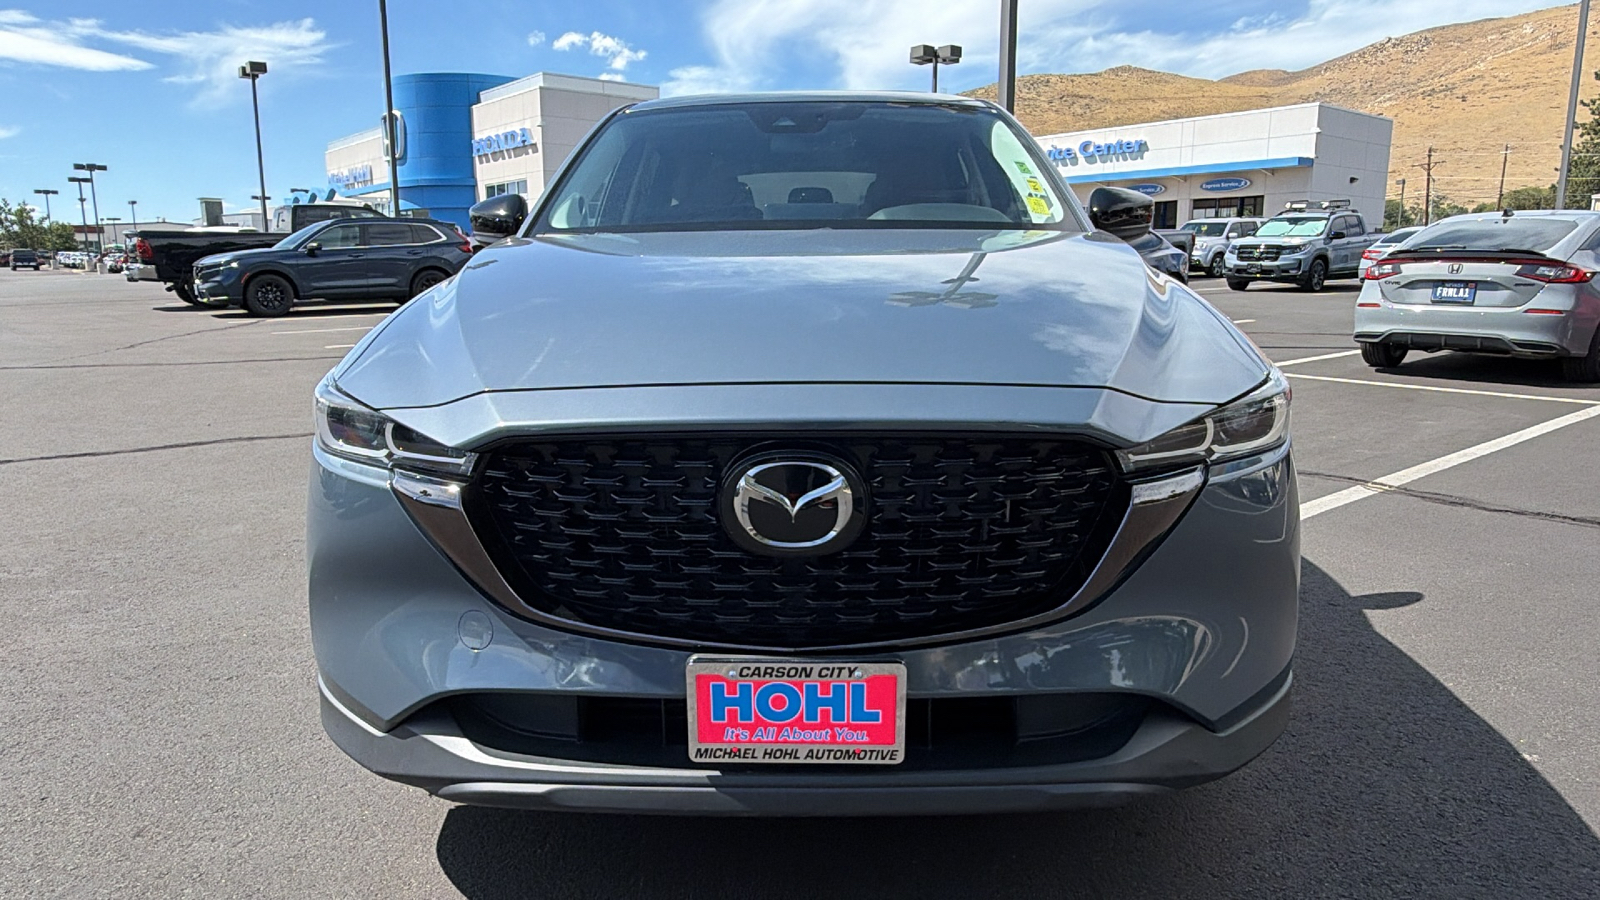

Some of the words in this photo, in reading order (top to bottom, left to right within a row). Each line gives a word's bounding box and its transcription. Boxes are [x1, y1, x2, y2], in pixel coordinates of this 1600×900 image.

[472, 128, 533, 157] HONDA
[1079, 139, 1145, 157] Center
[739, 666, 813, 679] CARSON
[817, 666, 858, 679] CITY
[710, 682, 882, 723] HOHL
[724, 727, 749, 741] It's
[753, 727, 777, 741] All
[778, 727, 831, 741] About
[834, 727, 869, 742] You.
[694, 747, 758, 760] MICHAEL
[762, 748, 801, 761] HOHL
[804, 748, 899, 761] AUTOMOTIVE
